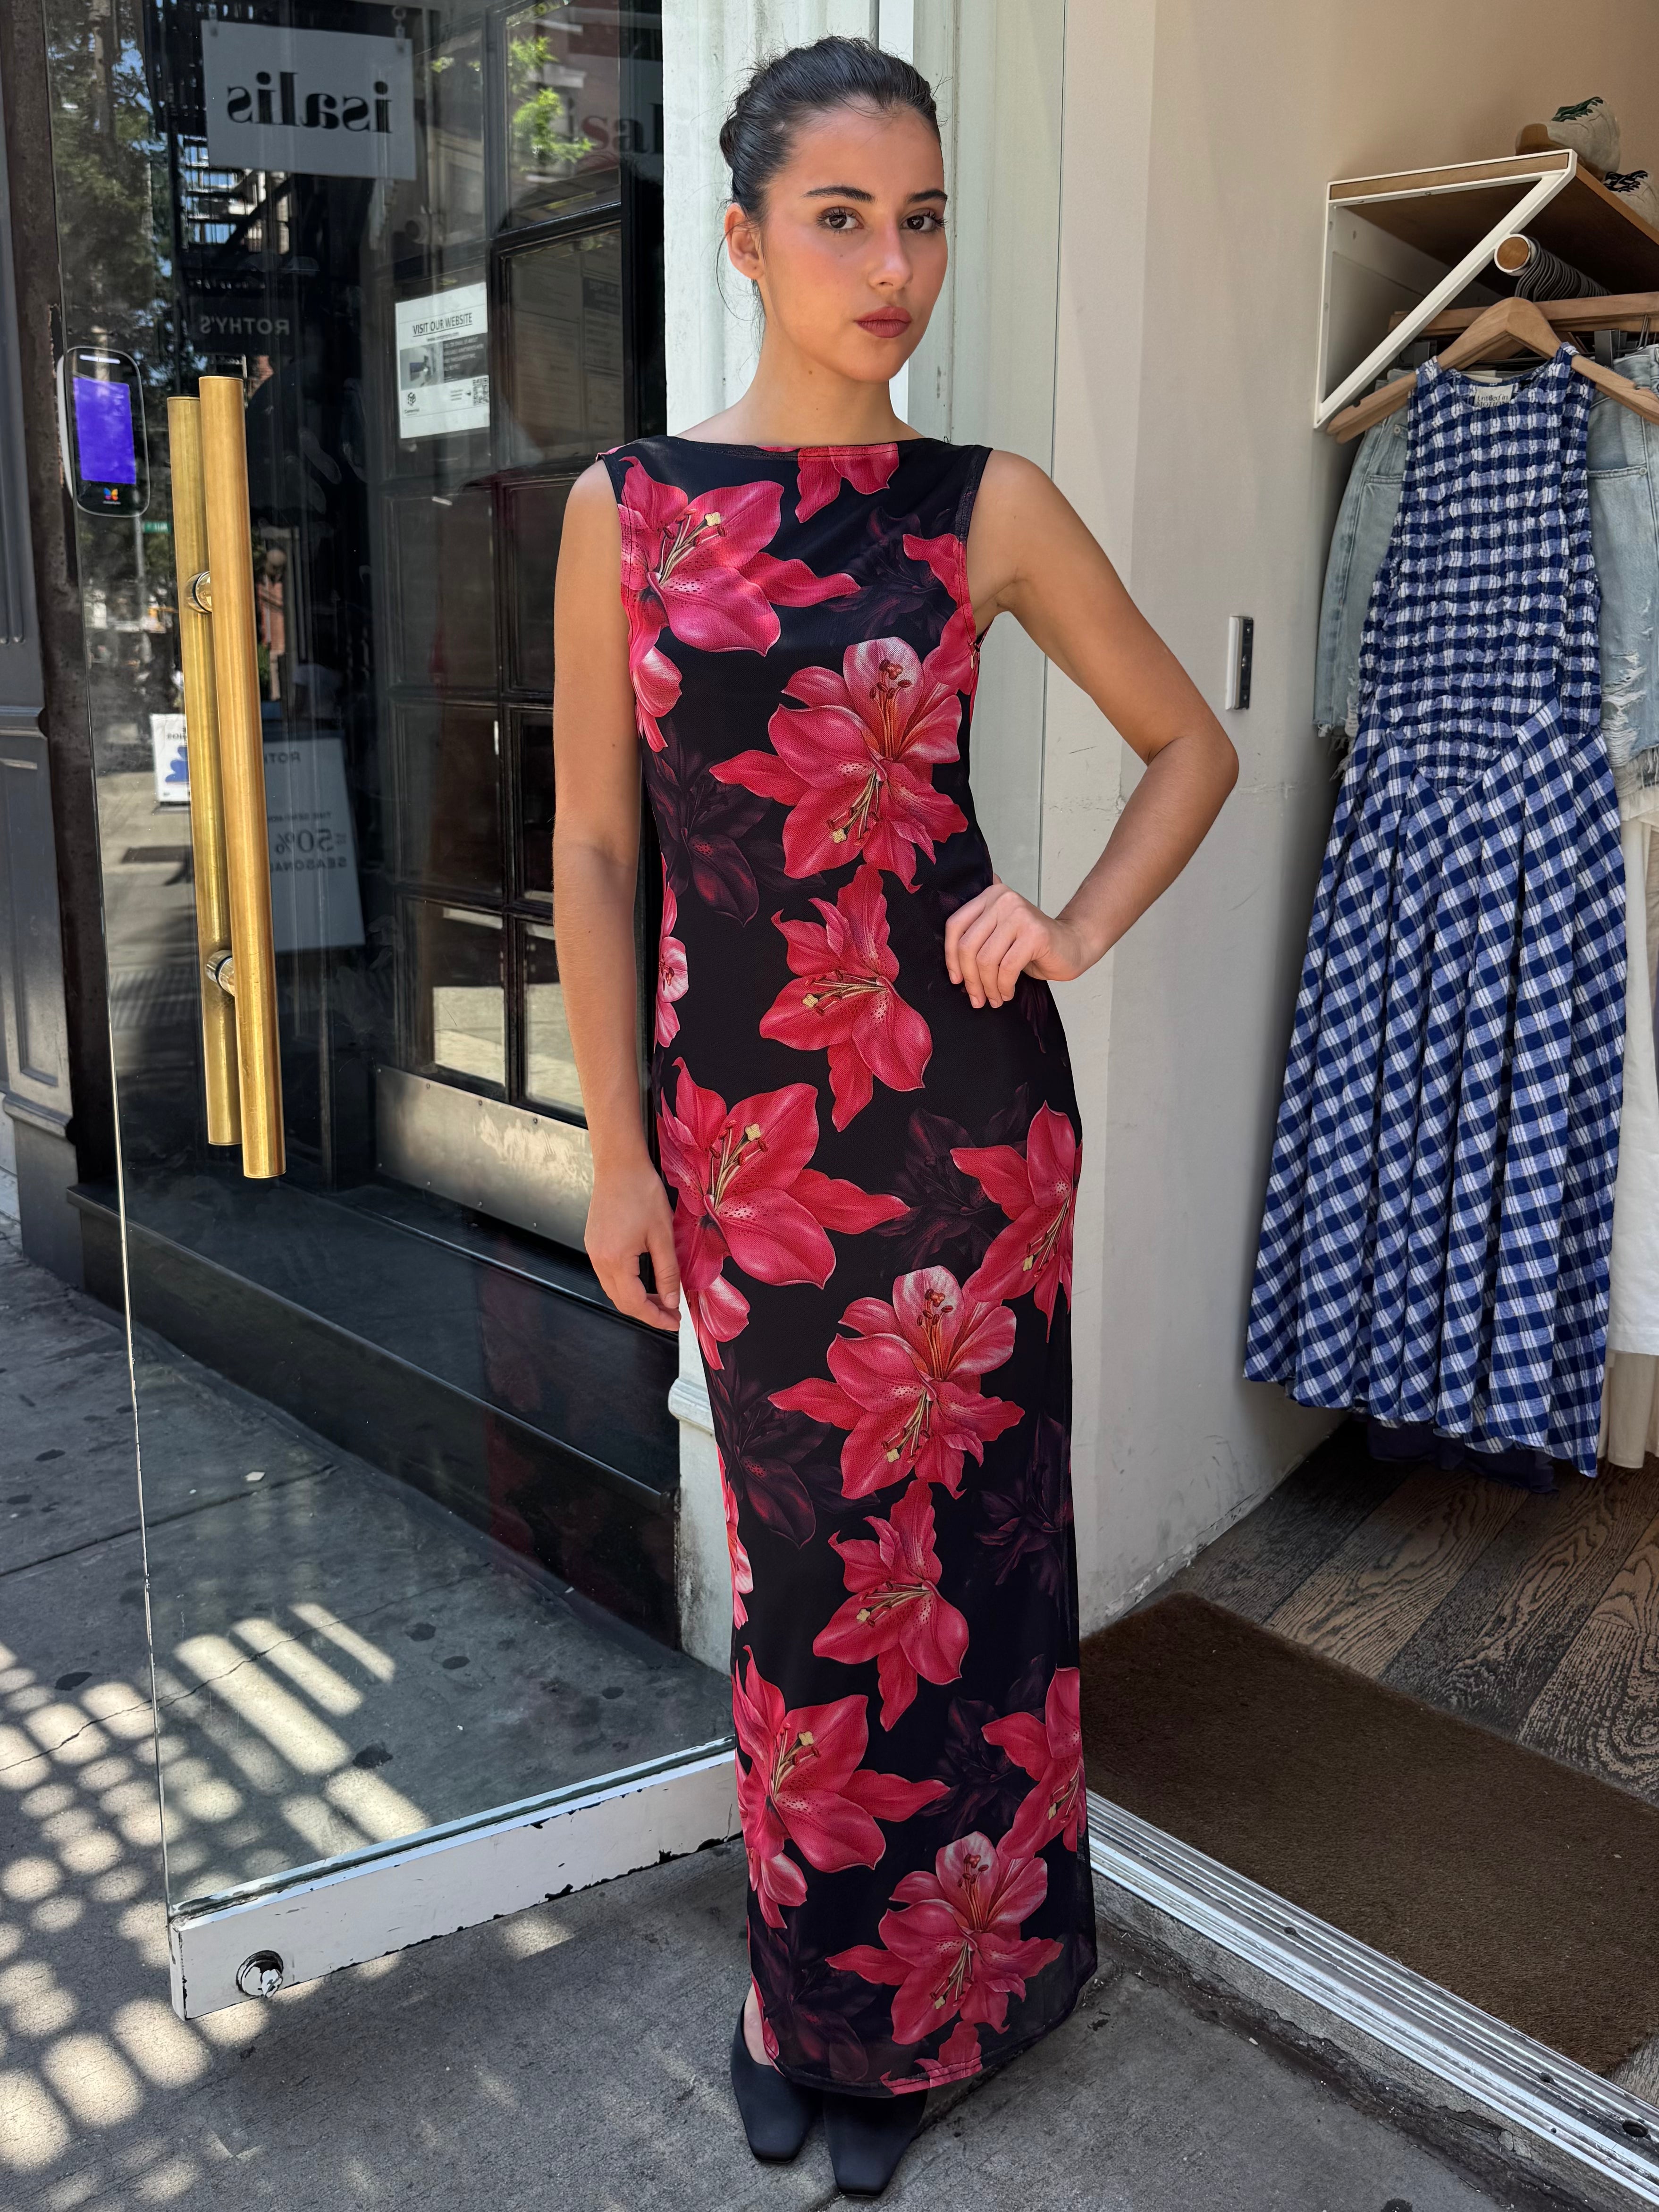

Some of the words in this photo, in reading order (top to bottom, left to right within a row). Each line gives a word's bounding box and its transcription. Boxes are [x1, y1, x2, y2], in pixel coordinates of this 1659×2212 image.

[413, 323, 427, 334] VISIT
[430, 320, 443, 331] OUR
[446, 313, 472, 327] WEBSITE
